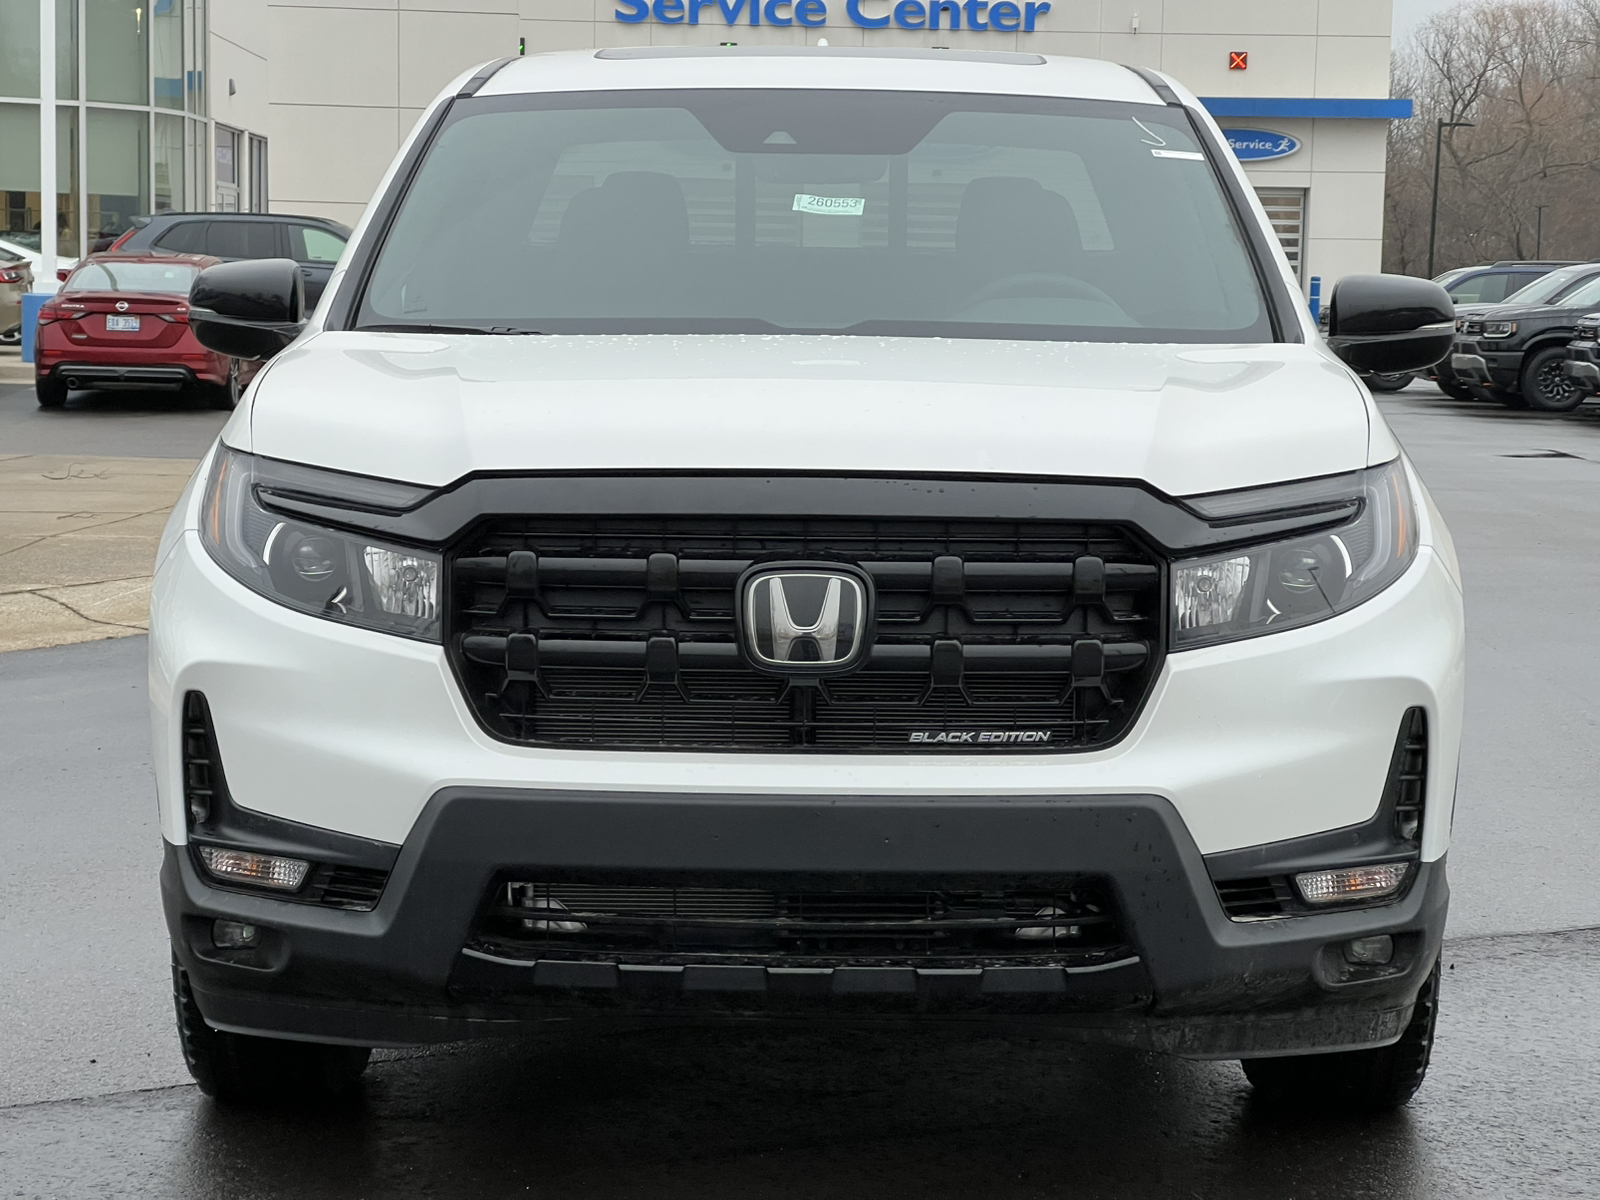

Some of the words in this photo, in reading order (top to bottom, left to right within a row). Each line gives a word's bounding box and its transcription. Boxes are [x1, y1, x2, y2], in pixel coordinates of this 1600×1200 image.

[615, 0, 826, 27] Service
[846, 0, 1051, 33] Center
[1228, 139, 1273, 150] Service
[808, 195, 858, 208] 260553
[908, 731, 976, 743] BLACK
[977, 731, 1051, 742] EDITION
